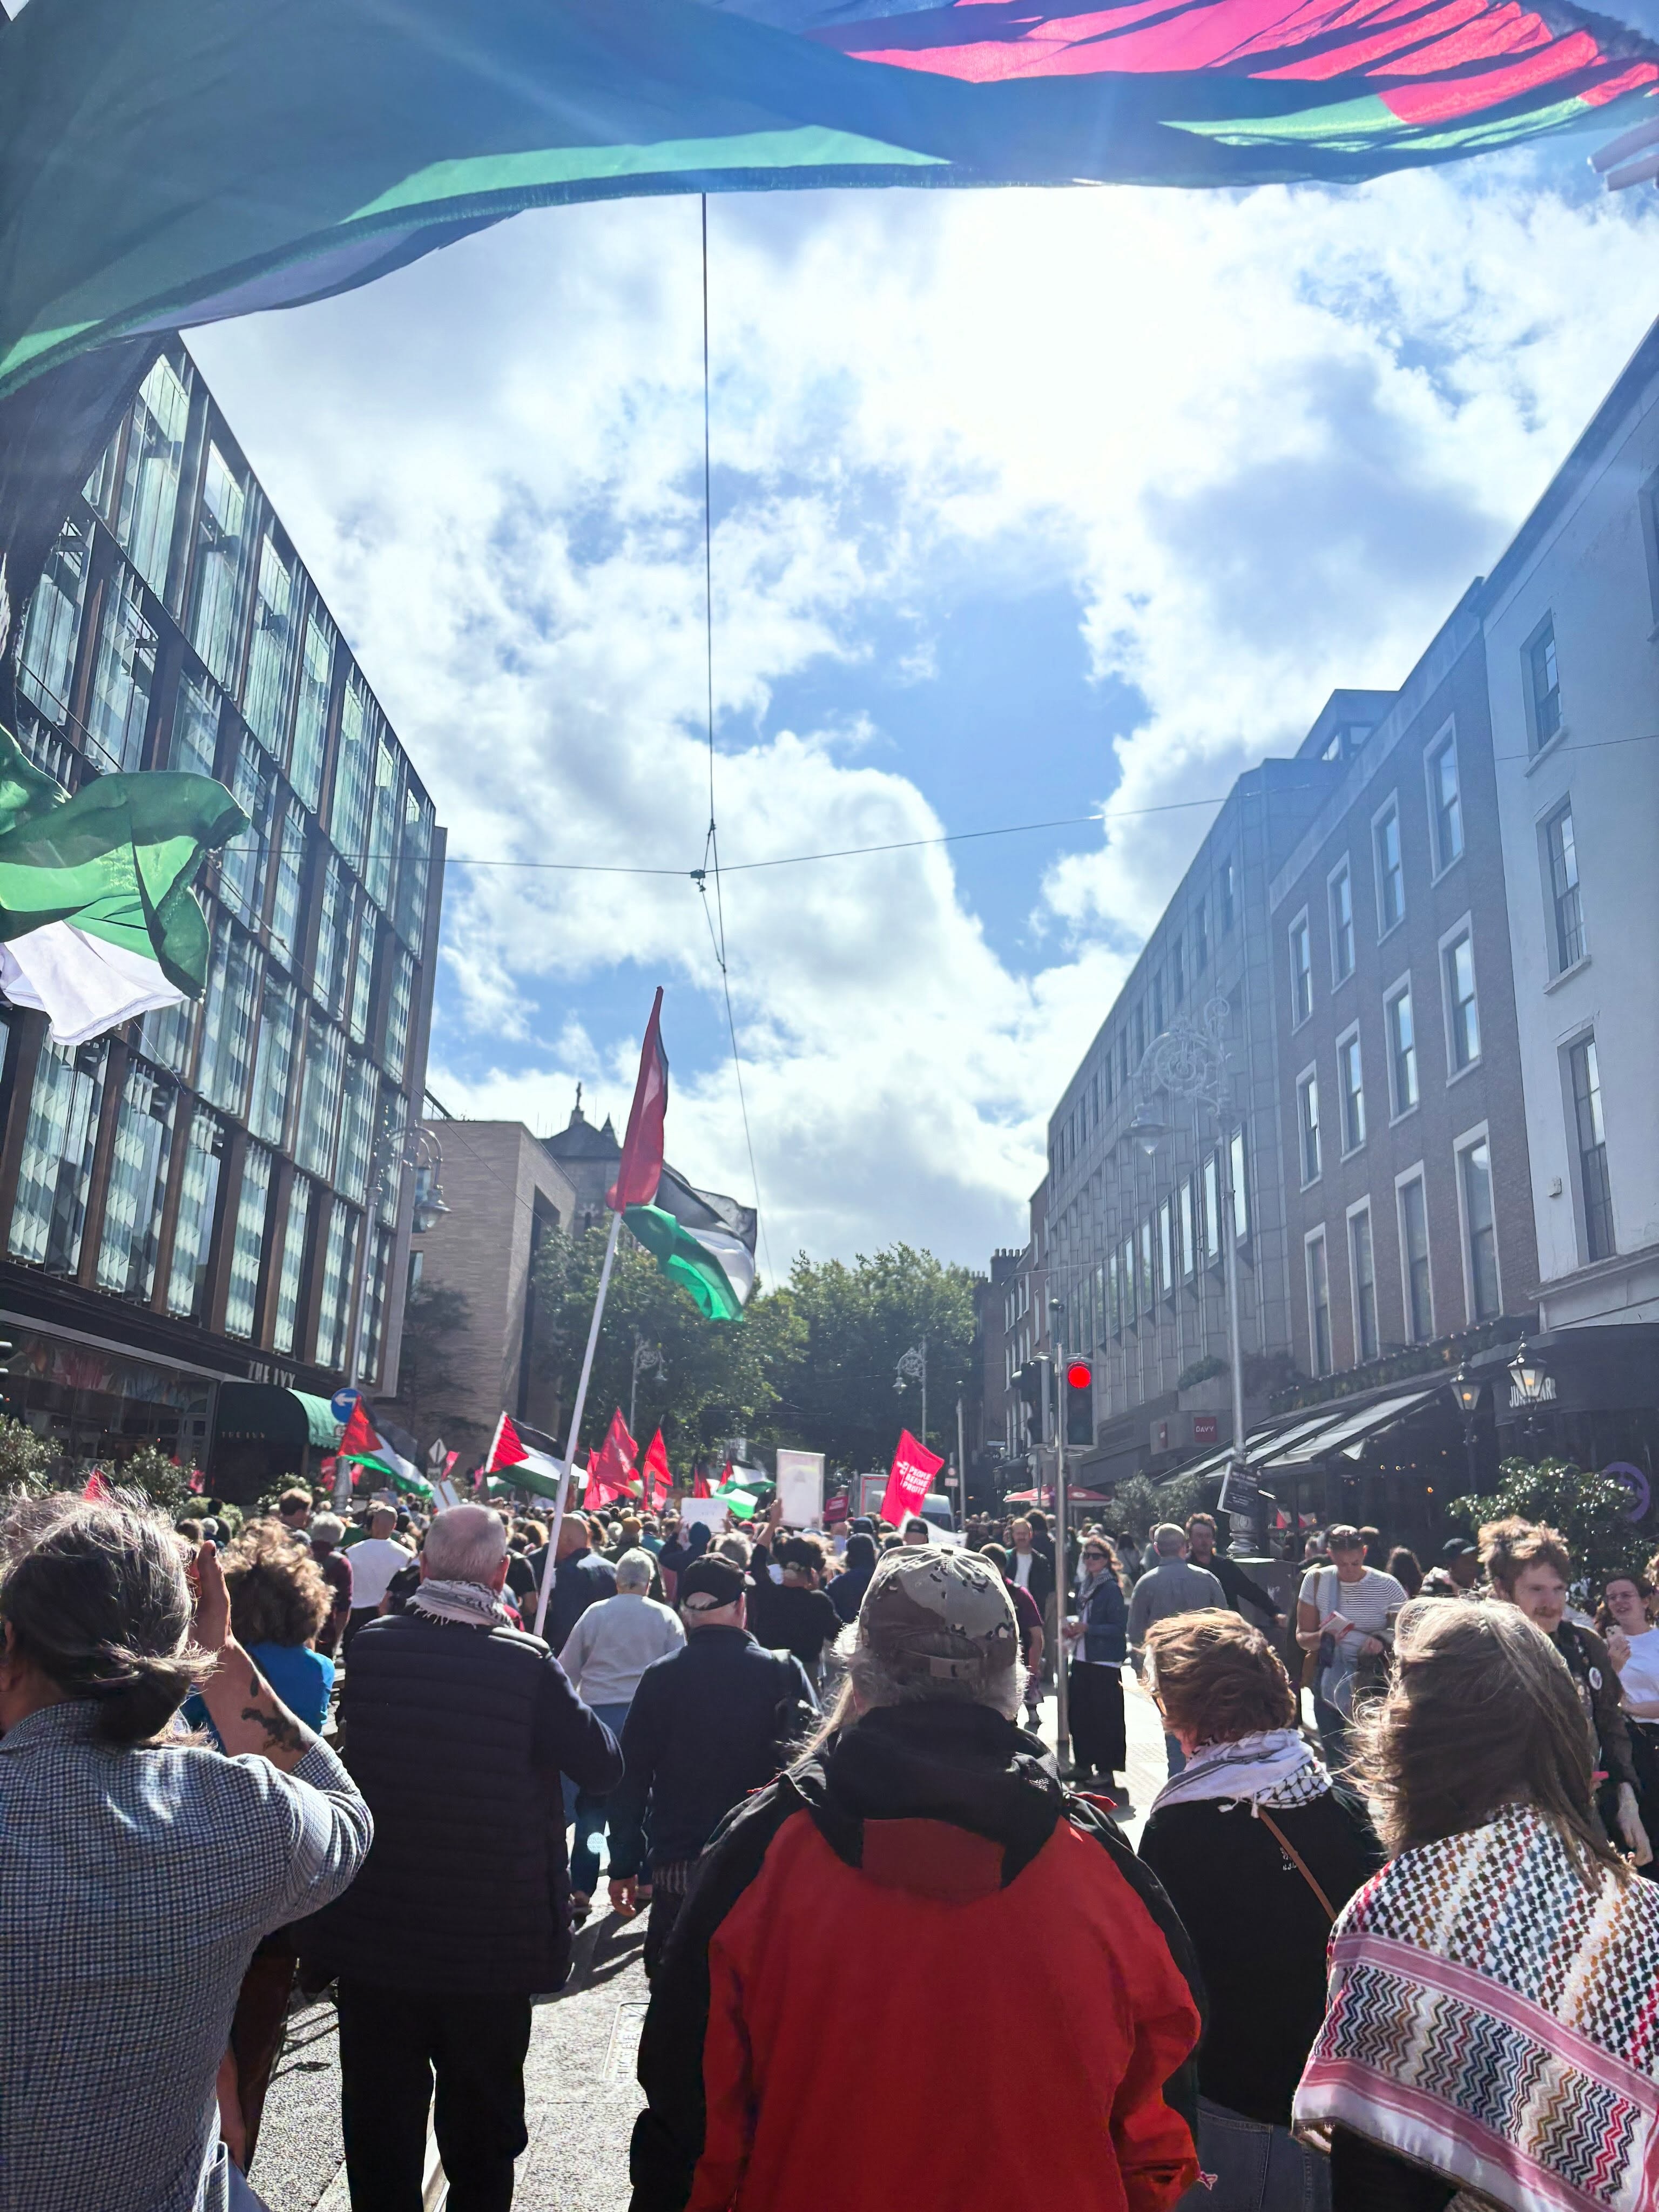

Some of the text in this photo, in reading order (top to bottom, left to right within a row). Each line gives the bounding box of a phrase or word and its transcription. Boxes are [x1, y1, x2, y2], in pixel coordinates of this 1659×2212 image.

[248, 1360, 295, 1388] THE IVY
[905, 1473, 928, 1488] BEFORE
[909, 1466, 932, 1480] PEOPLE
[902, 1480, 925, 1495] PROFIT
